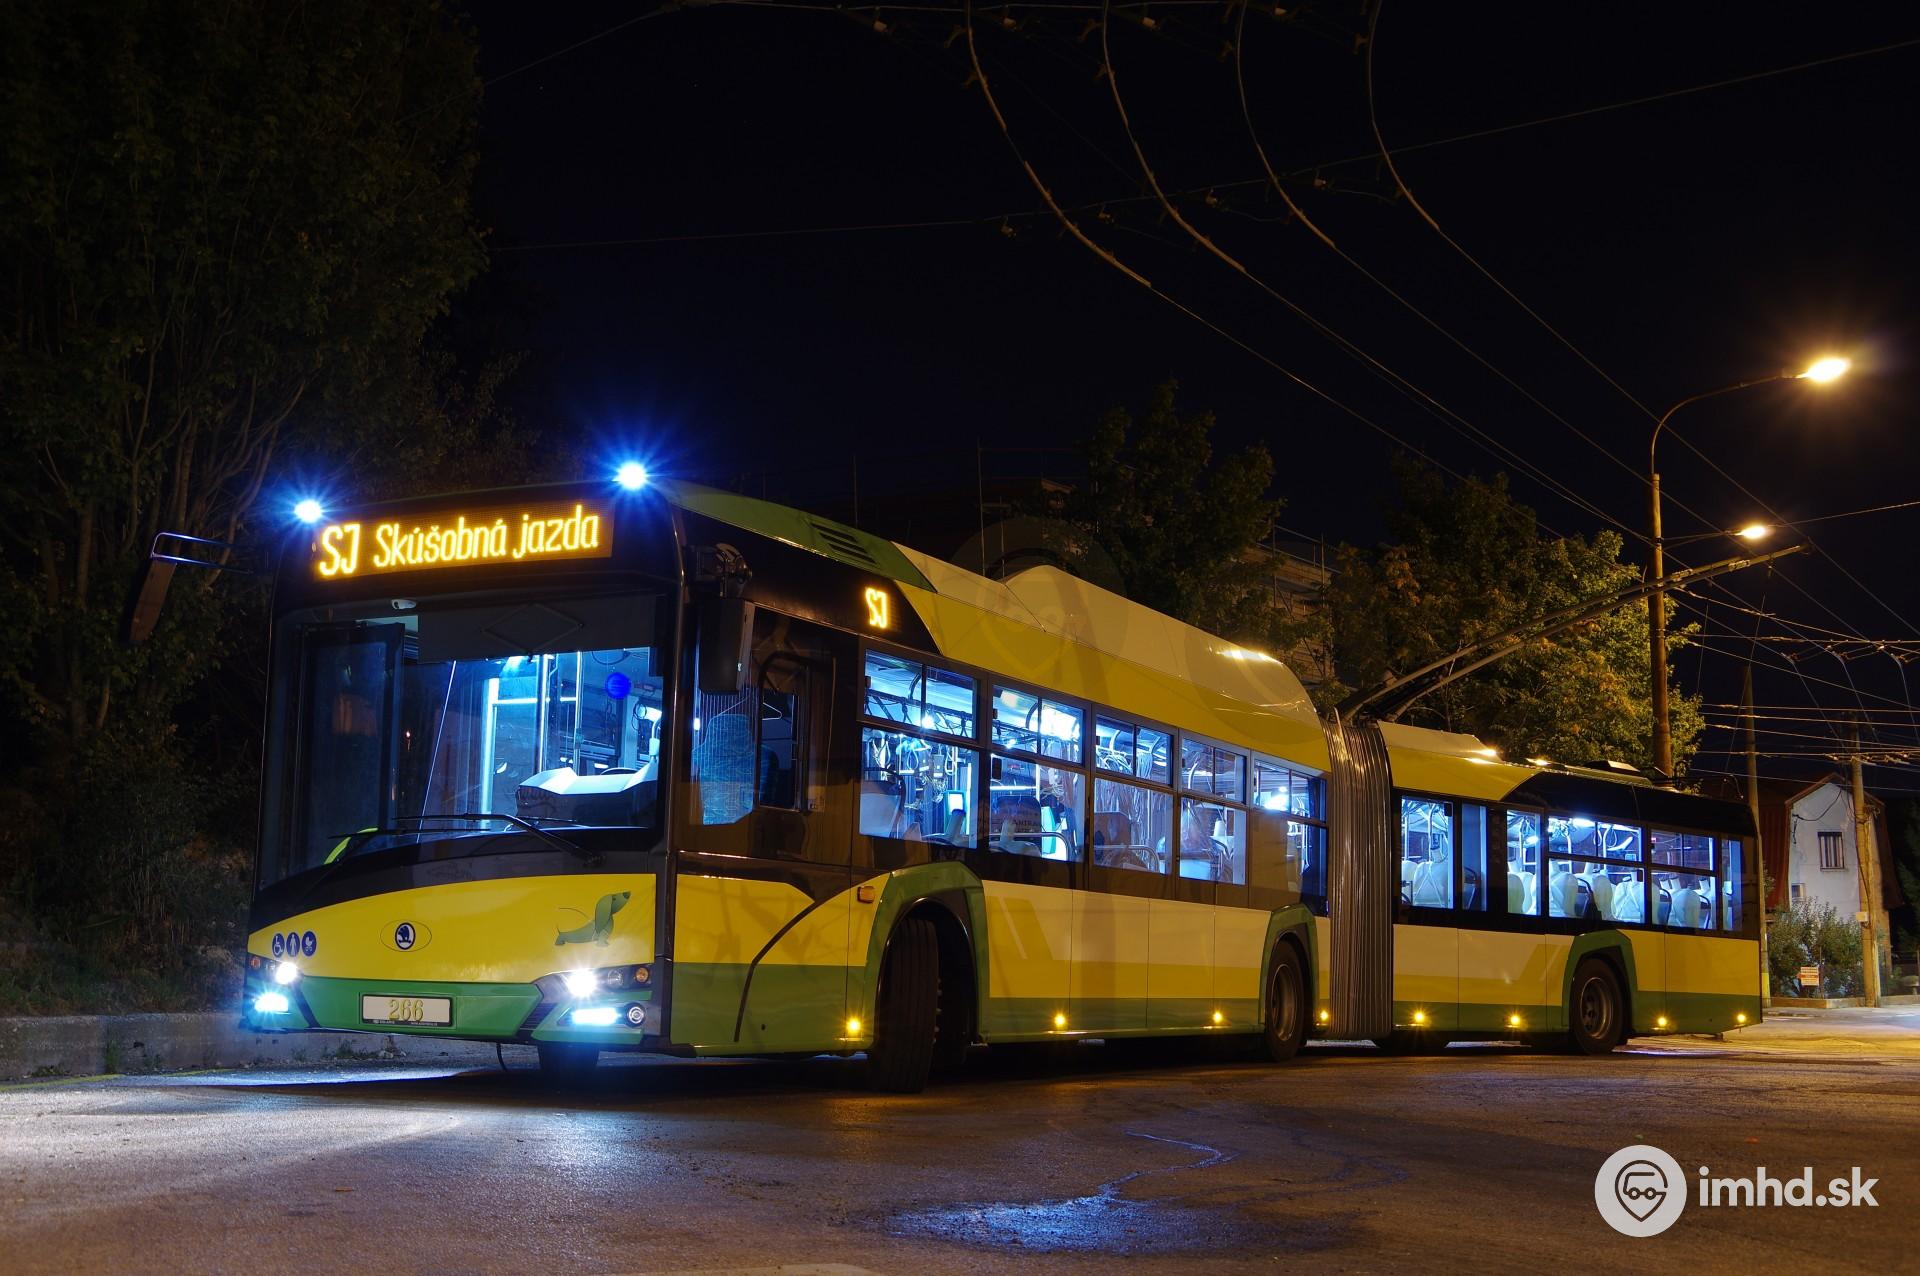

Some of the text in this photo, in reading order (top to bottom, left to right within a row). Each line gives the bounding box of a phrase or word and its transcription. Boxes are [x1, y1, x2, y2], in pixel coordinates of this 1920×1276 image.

[373, 516, 507, 568] Skúšobná
[513, 504, 599, 559] jazda
[388, 999, 424, 1022] 266
